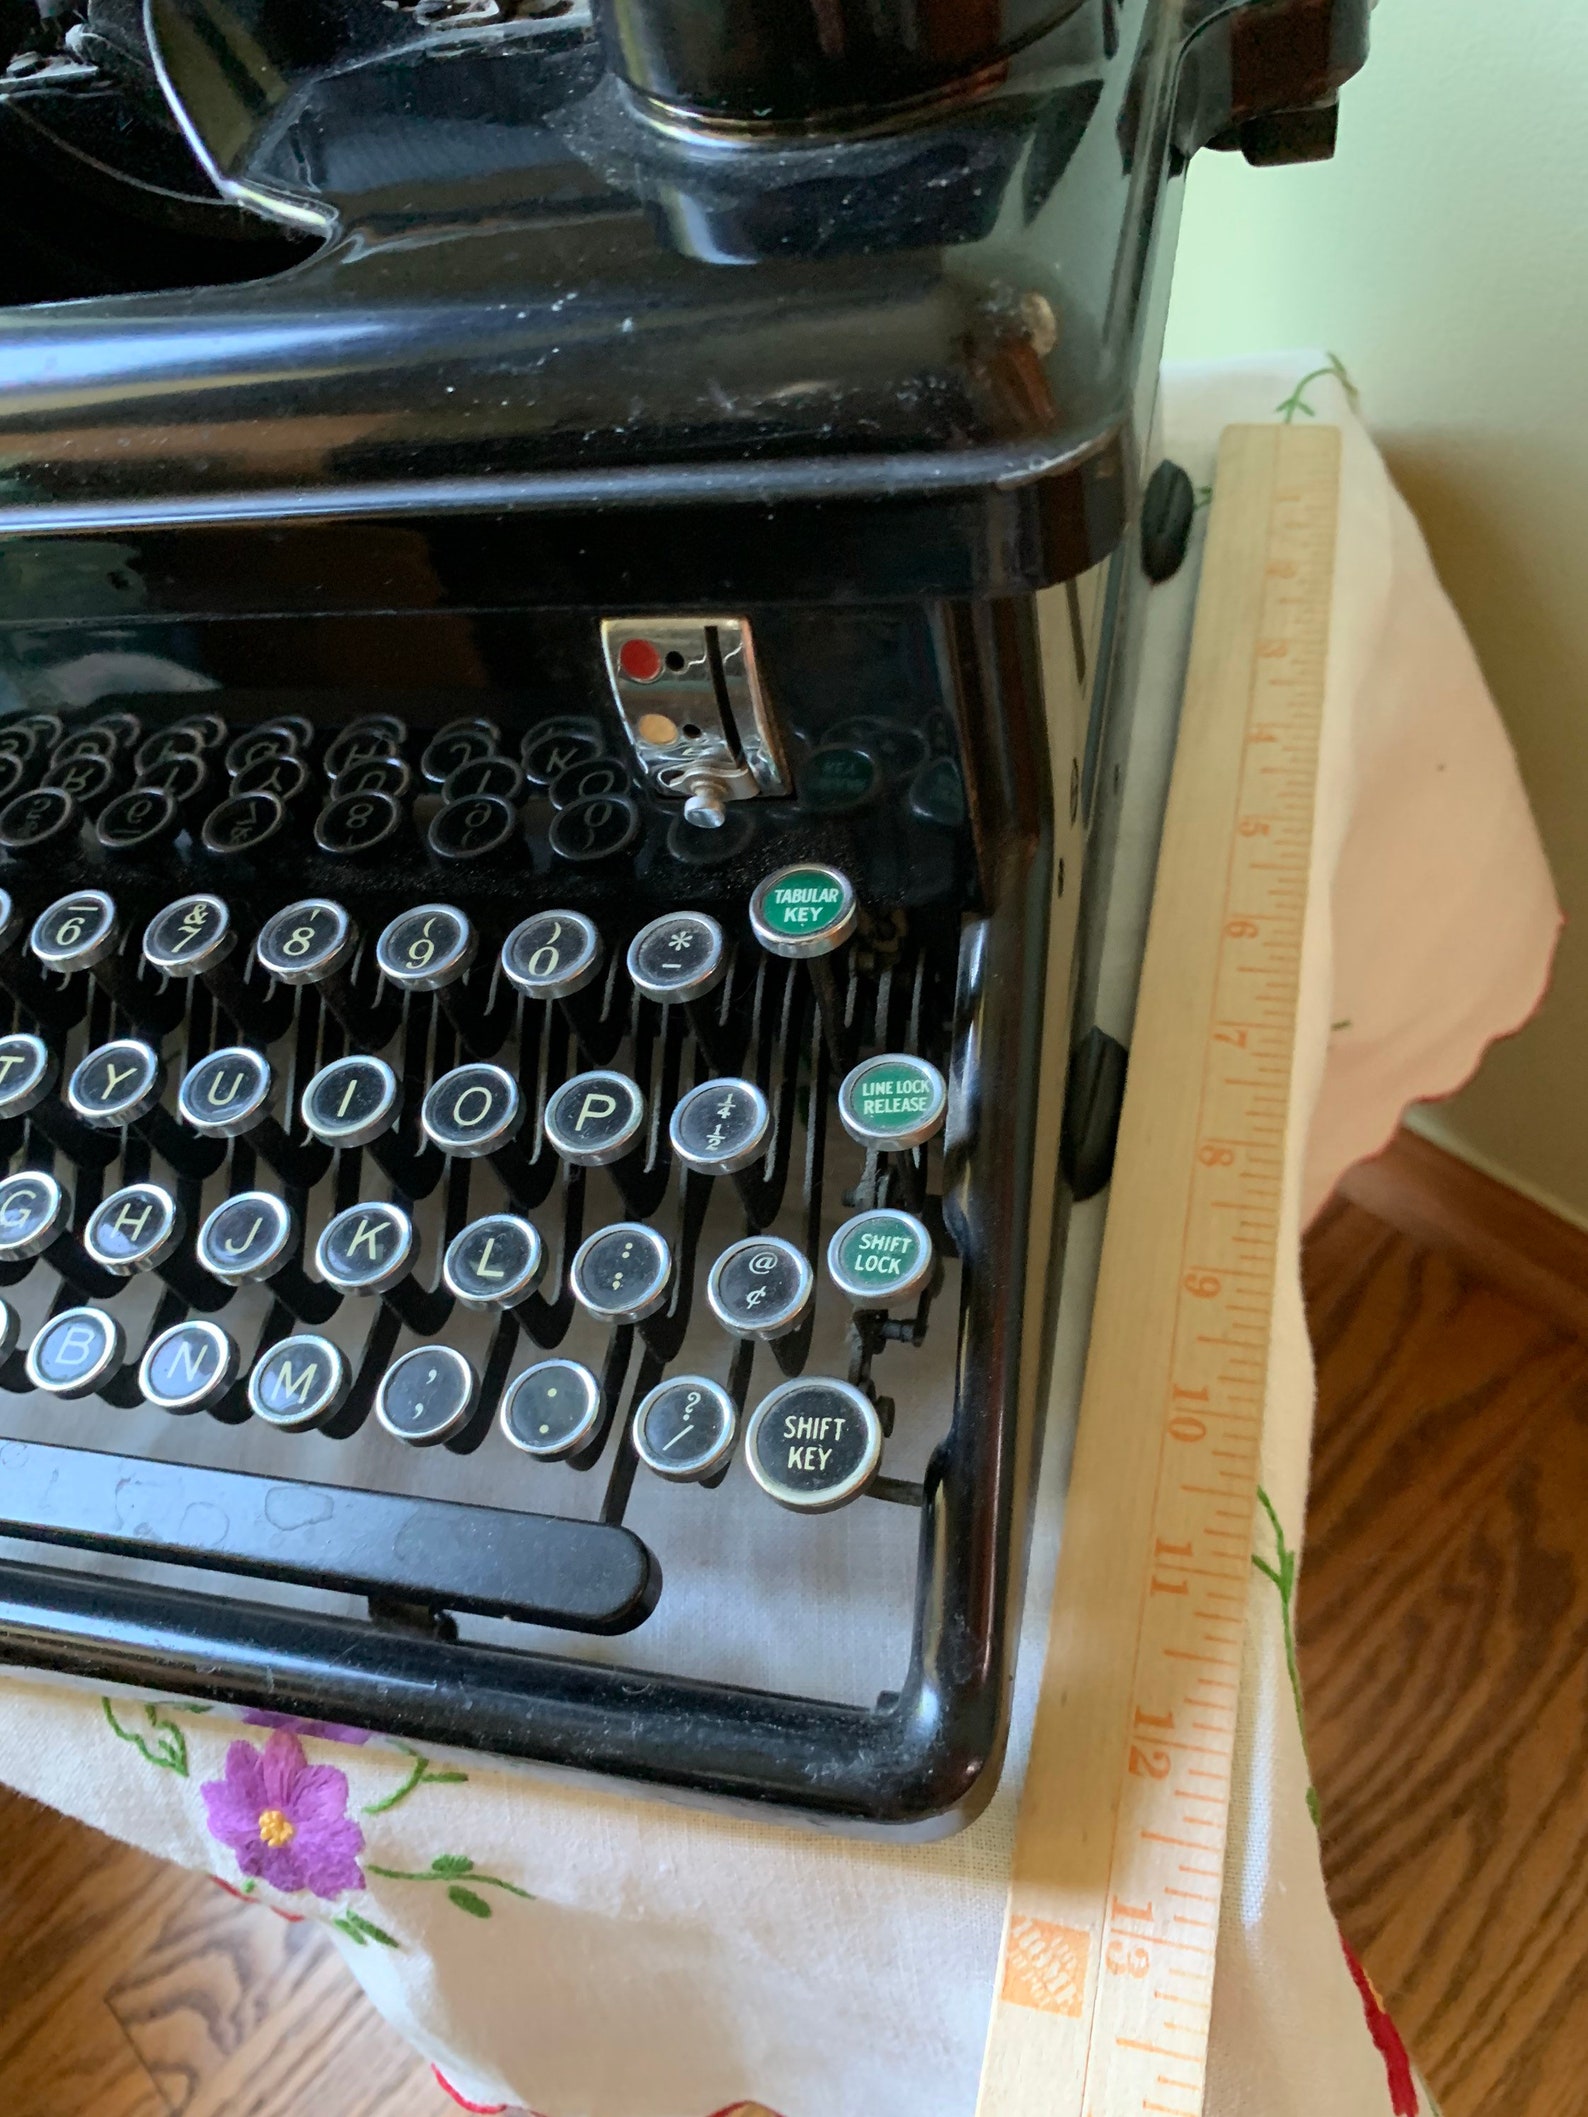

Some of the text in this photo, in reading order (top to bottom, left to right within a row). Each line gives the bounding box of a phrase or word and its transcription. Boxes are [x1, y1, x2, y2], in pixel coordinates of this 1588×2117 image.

[1238, 817, 1270, 838] 5
[775, 888, 840, 904] TABULAR
[183, 903, 208, 925] &
[783, 907, 824, 923] KEY
[56, 917, 85, 945] 6
[171, 925, 202, 953] 7
[283, 927, 315, 956] 8
[1224, 920, 1259, 940] 6
[405, 938, 435, 969] 9
[1213, 1028, 1248, 1050] 7
[101, 1063, 138, 1100] Y
[207, 1071, 244, 1106] U
[862, 1079, 930, 1096] LINE LOCK
[337, 1079, 357, 1117] I
[453, 1087, 492, 1126] O
[575, 1094, 617, 1131] P
[863, 1097, 928, 1114] RELEASE
[1198, 1144, 1235, 1168] 8
[2, 1190, 37, 1227] G
[111, 1203, 153, 1241] H
[225, 1218, 263, 1256] J
[346, 1220, 391, 1260] K
[859, 1233, 912, 1253] SHIFT
[476, 1238, 505, 1277] L
[748, 1252, 778, 1275] @
[854, 1255, 902, 1275] LOCK
[1183, 1273, 1221, 1299] 9
[55, 1326, 96, 1365] B
[166, 1341, 208, 1382] N
[271, 1361, 318, 1404] M
[1167, 1383, 1210, 1443] 10
[783, 1416, 846, 1441] SHIFT
[788, 1446, 833, 1471] KEY
[1150, 1537, 1193, 1597] 11
[1128, 1705, 1175, 1782] 12
[1105, 1895, 1154, 1980] 13
